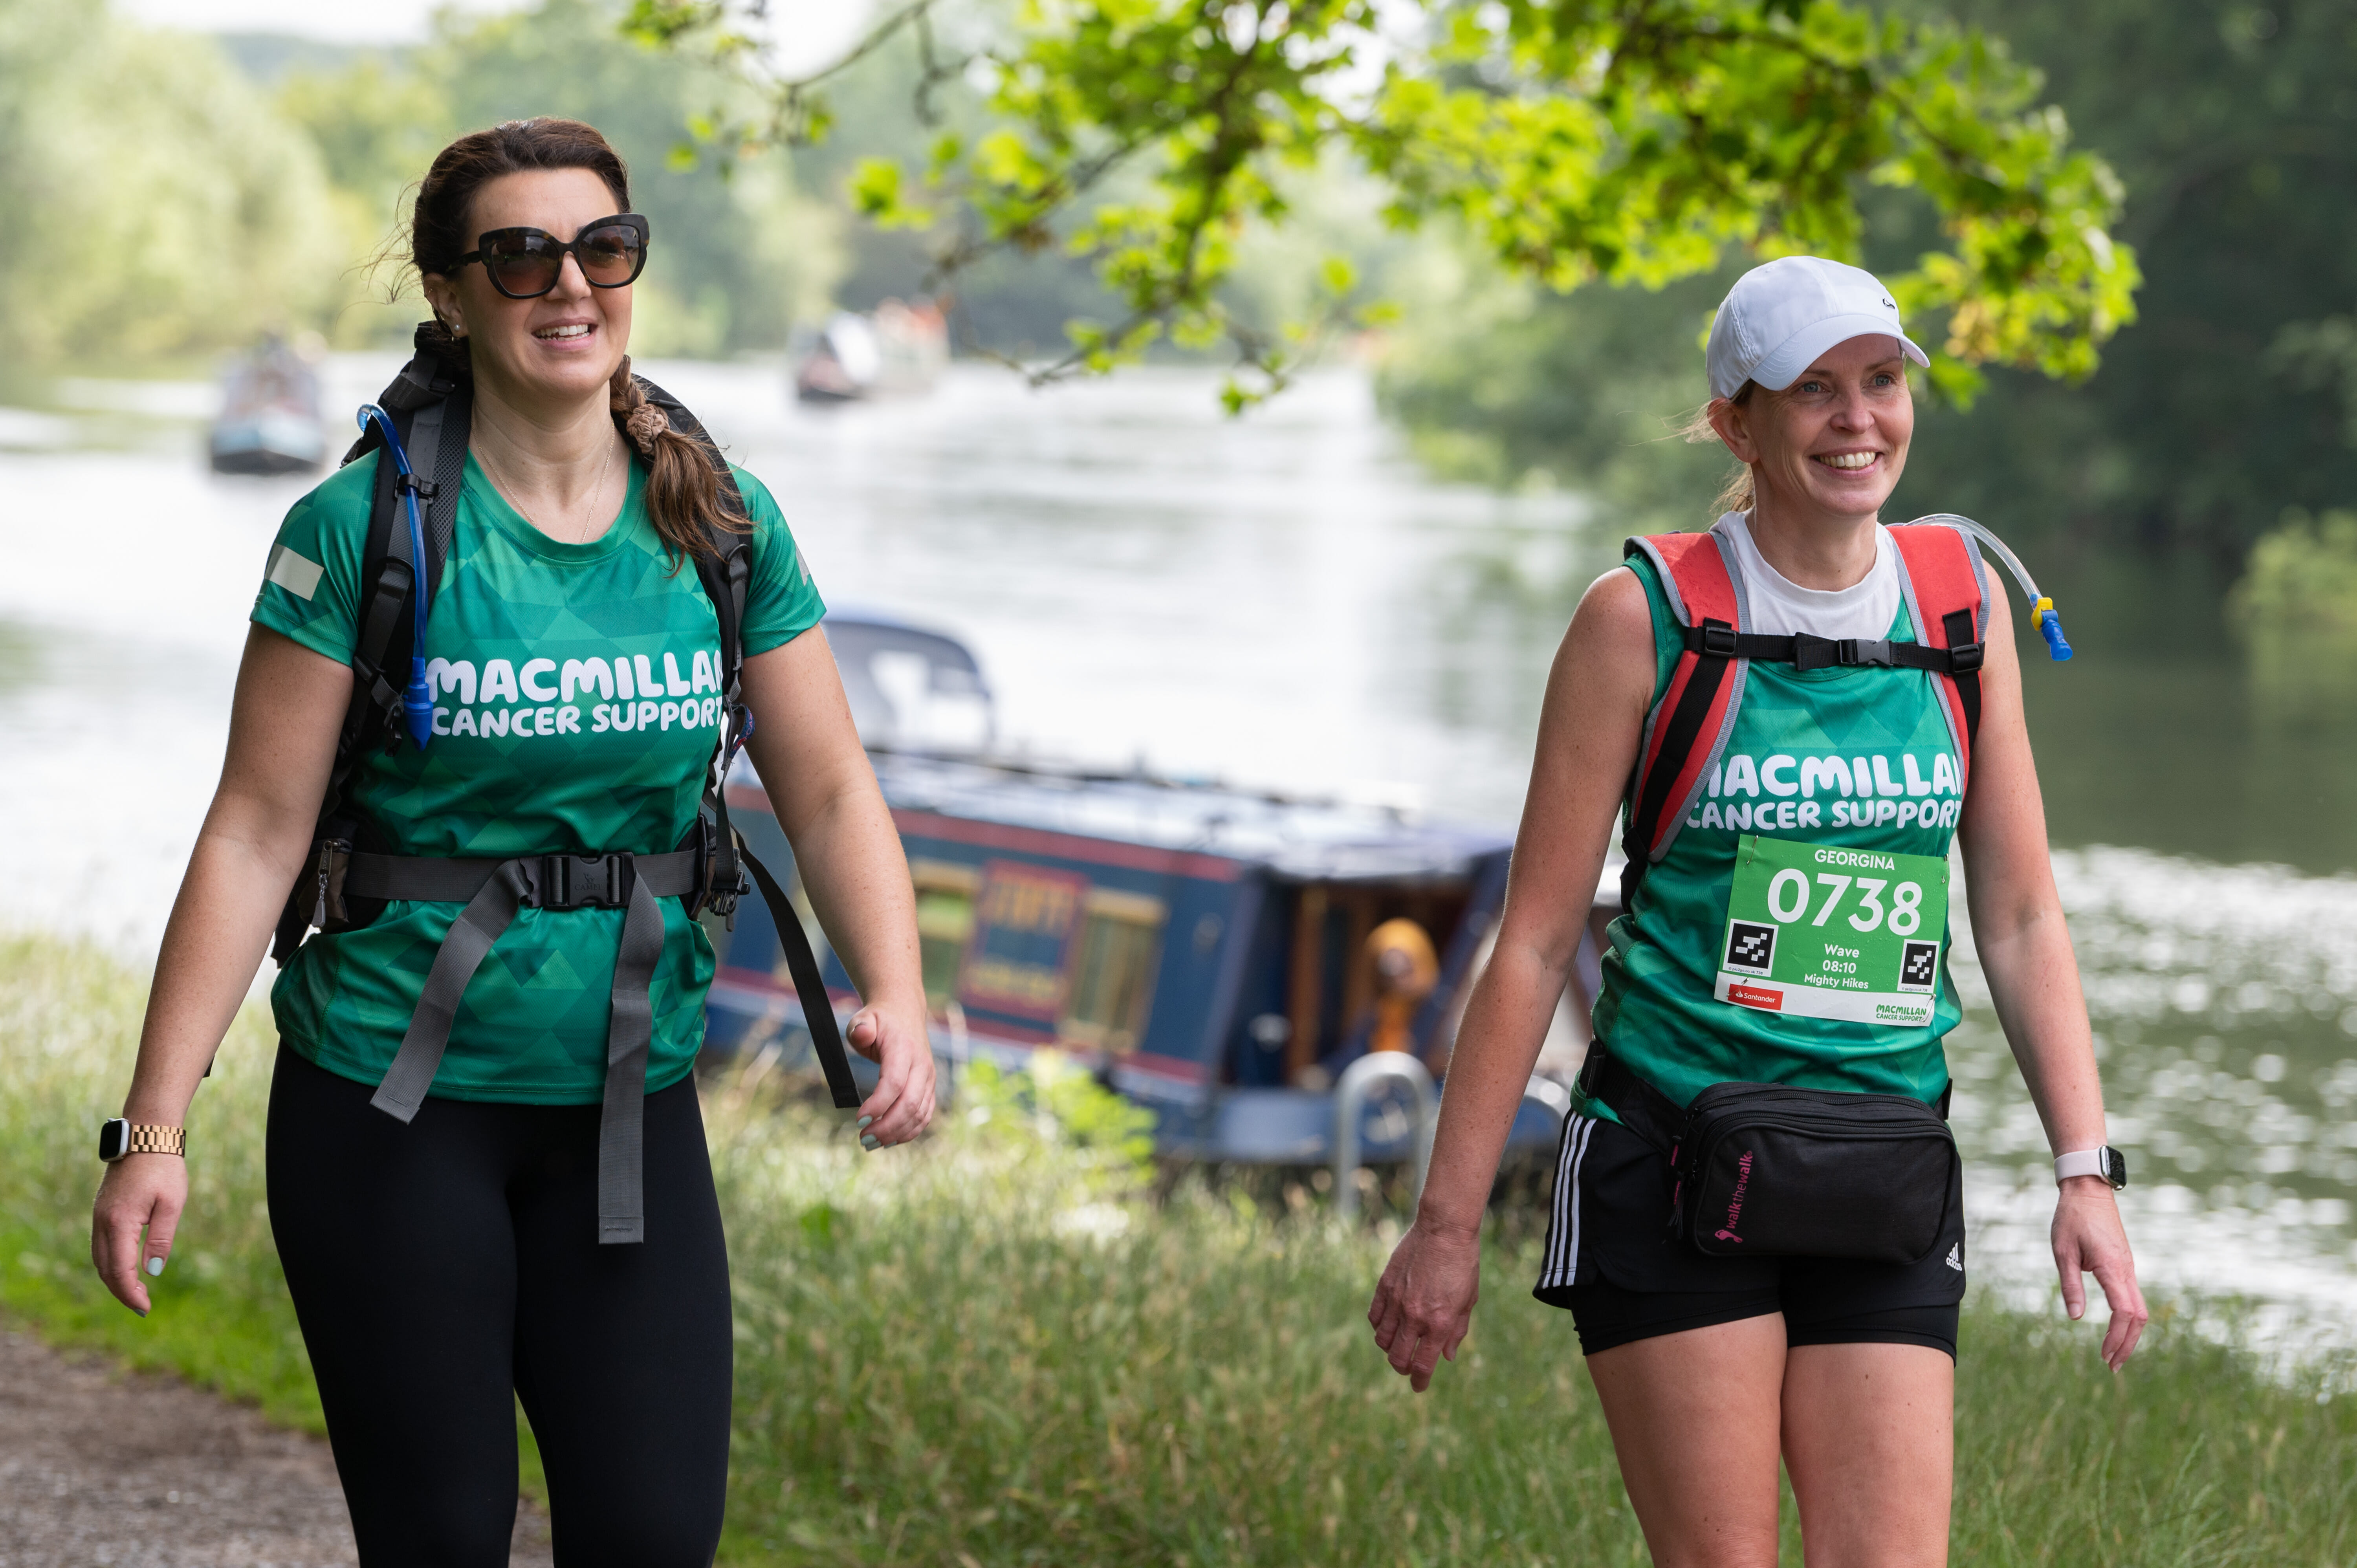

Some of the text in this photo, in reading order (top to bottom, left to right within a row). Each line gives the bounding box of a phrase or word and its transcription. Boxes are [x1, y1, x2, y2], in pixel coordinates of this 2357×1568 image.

[431, 706, 581, 738] CANCER
[591, 696, 722, 733] SUPPORT
[1831, 799, 1961, 829] SUPPORT
[1814, 849, 1895, 870] GEORGINA
[1768, 868, 1922, 936] 0738
[1824, 943, 1859, 958] Wave
[1823, 960, 1856, 974] 08:10
[1804, 974, 1869, 989] Mighty Hikes
[1744, 993, 1776, 1003] Santander
[1876, 1004, 1927, 1016] MACMILLAN
[1946, 1257, 1963, 1271] adidas
